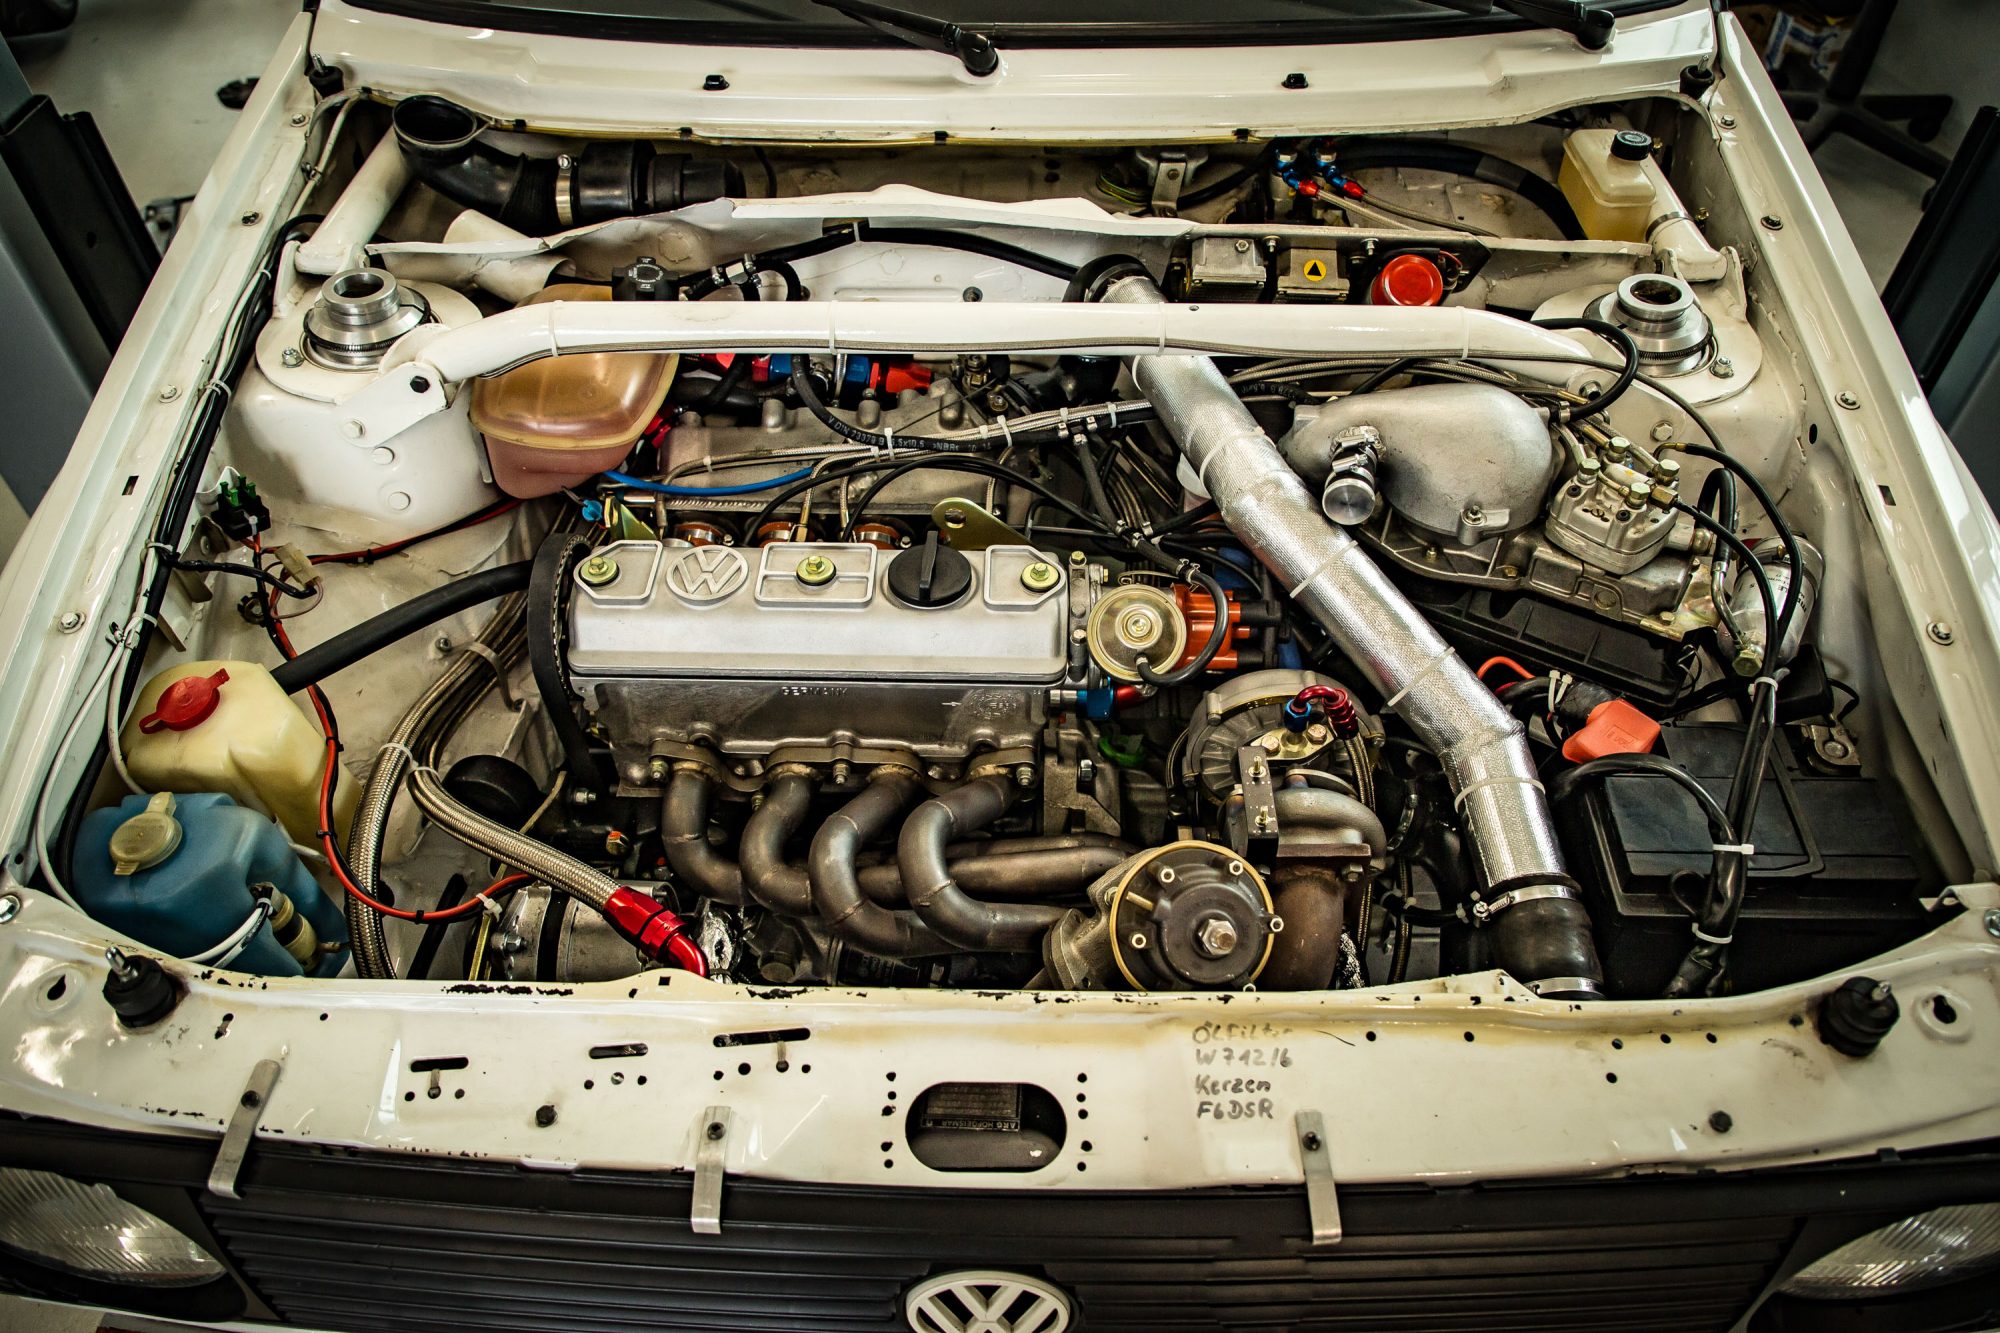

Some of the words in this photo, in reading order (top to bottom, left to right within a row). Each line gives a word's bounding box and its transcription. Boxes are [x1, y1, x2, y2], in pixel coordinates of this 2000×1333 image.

[834, 422, 851, 435] DIN
[667, 545, 748, 600] VW
[1195, 1074, 1271, 1096] Kerzen
[1197, 1098, 1274, 1120] F6DSR
